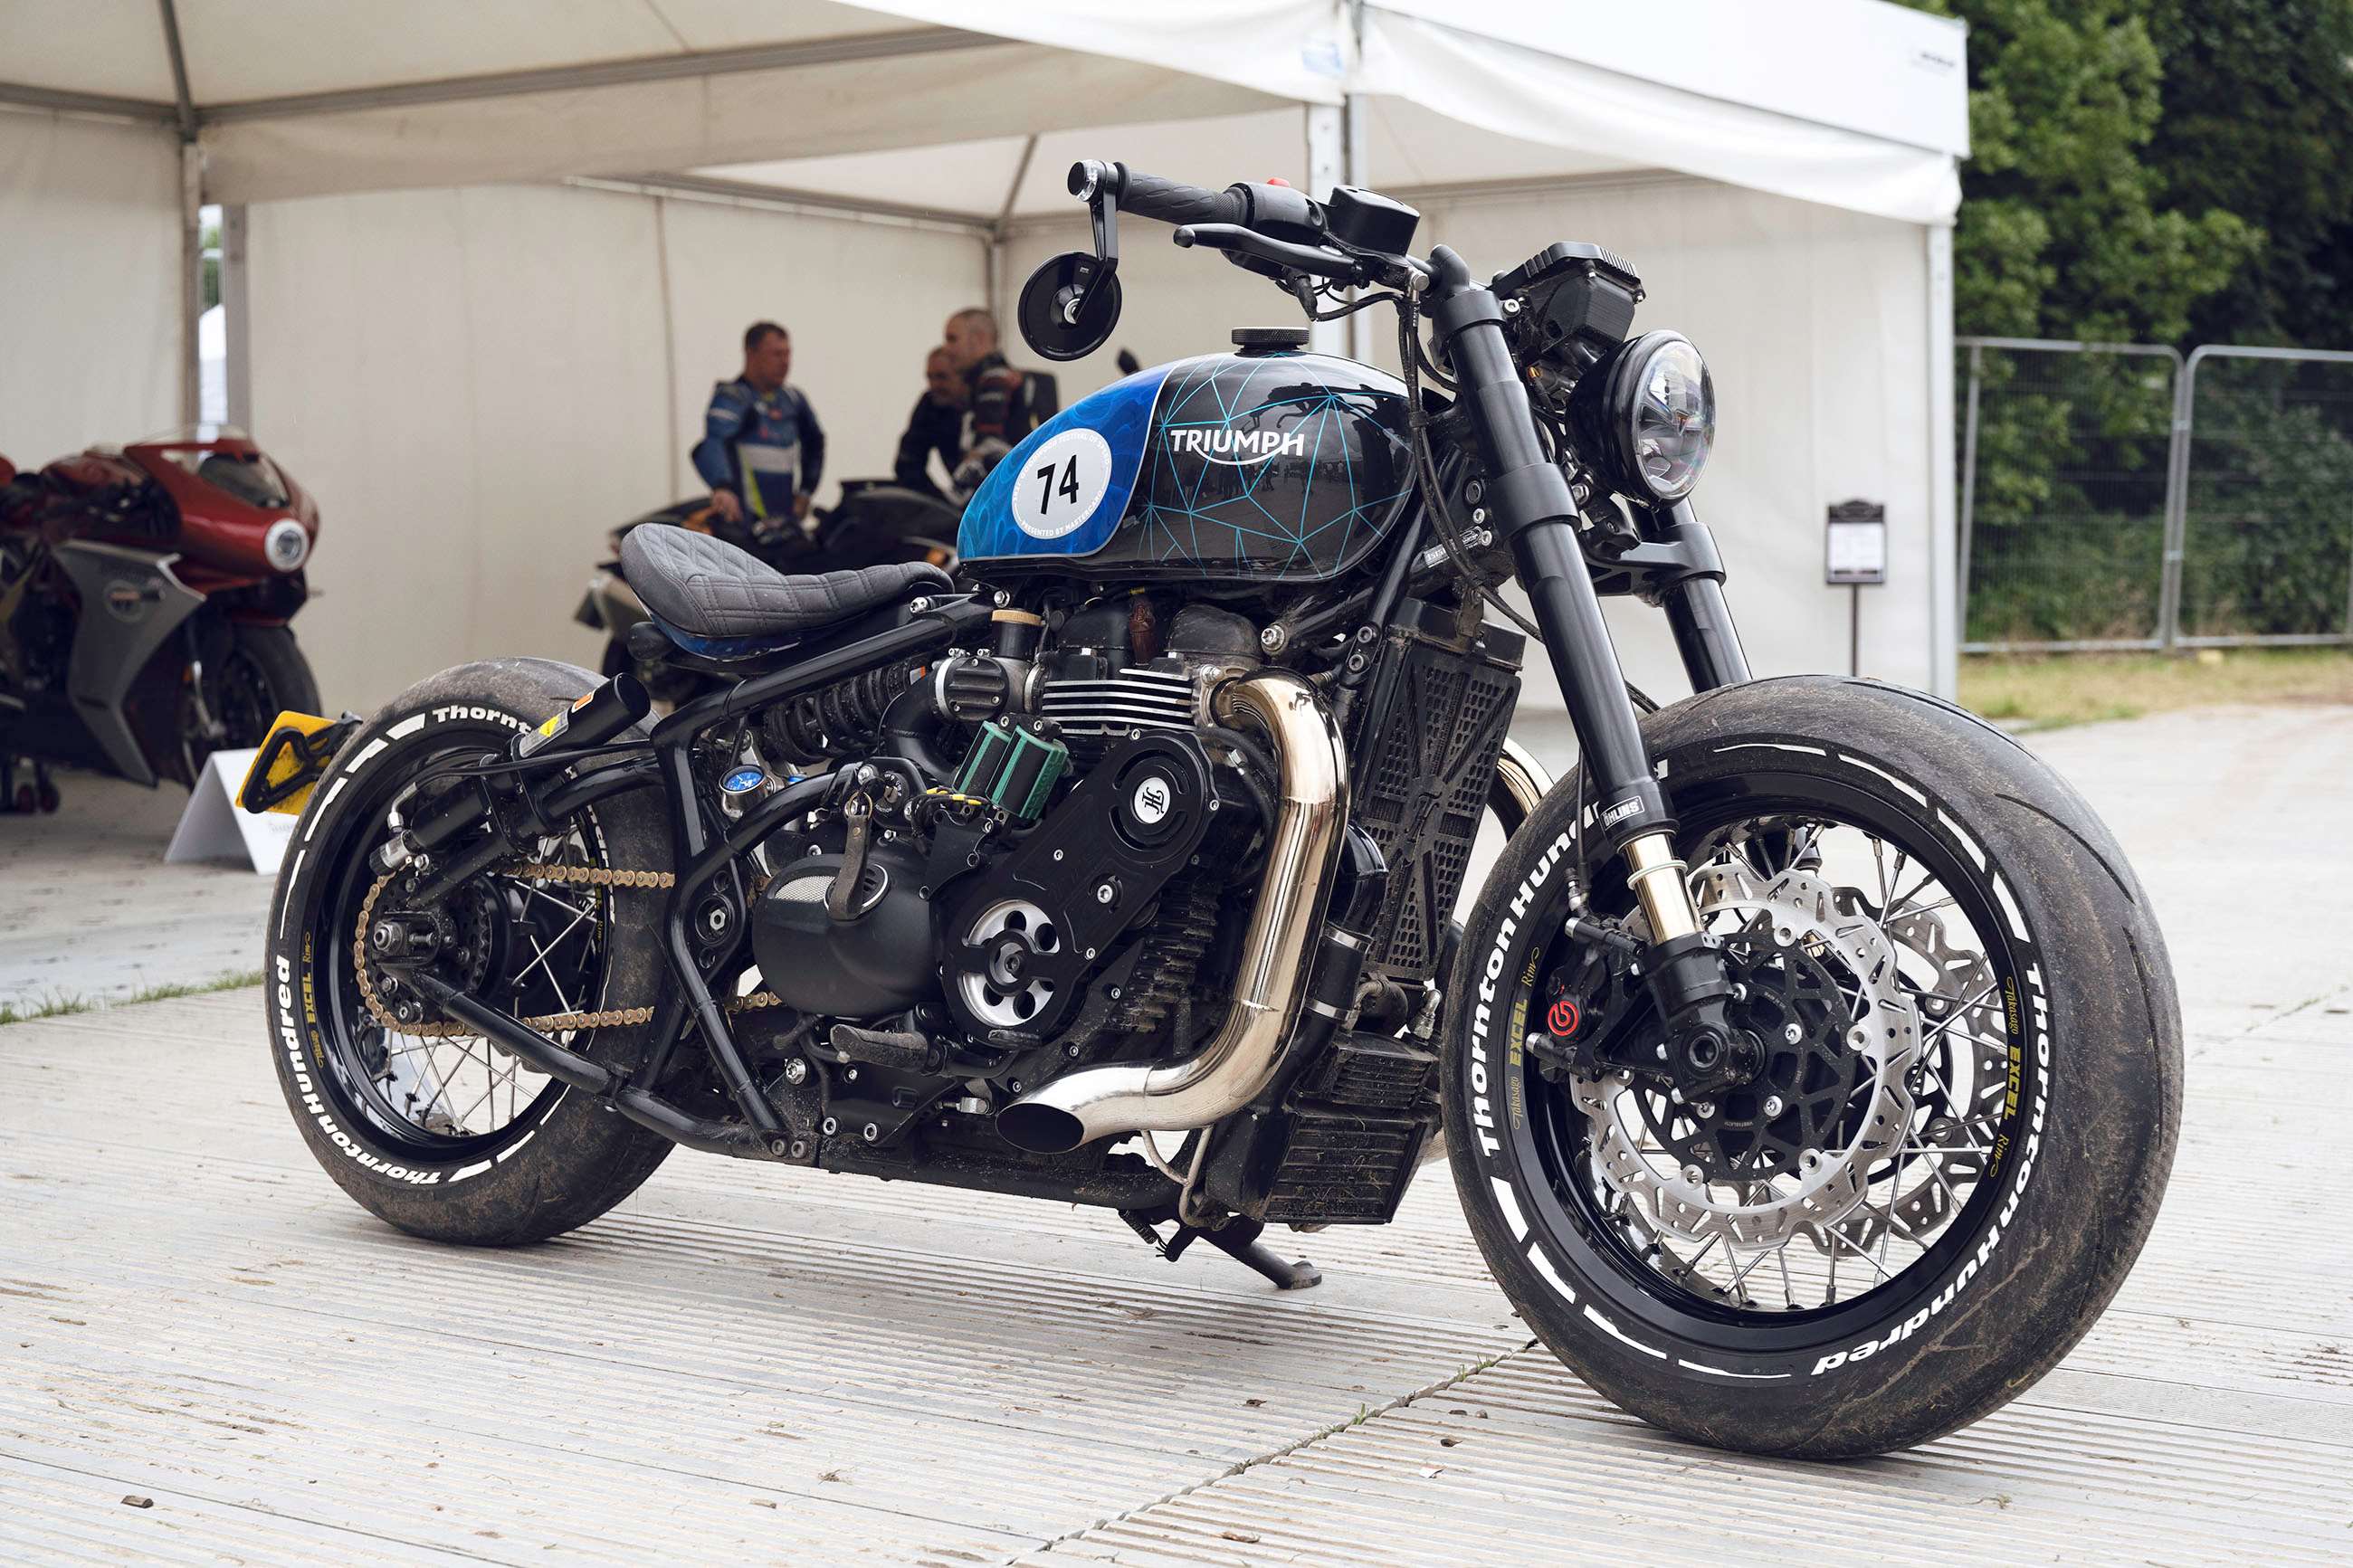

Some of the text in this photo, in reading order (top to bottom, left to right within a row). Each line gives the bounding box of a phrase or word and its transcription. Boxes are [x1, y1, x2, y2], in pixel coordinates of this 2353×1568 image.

[1037, 454, 1080, 515] 74
[1171, 429, 1305, 465] TRIUMPH
[433, 705, 532, 735] Thornt
[275, 955, 442, 1185] Thornton Hundred
[302, 973, 317, 1024] EXCEL
[1471, 917, 1518, 1158] Thornton
[1509, 946, 1540, 1130] Takasago EXCEL Rim
[1989, 976, 2022, 1178] Takasago EXCEL Rim
[1810, 962, 2051, 1376] Thornton Hundred
